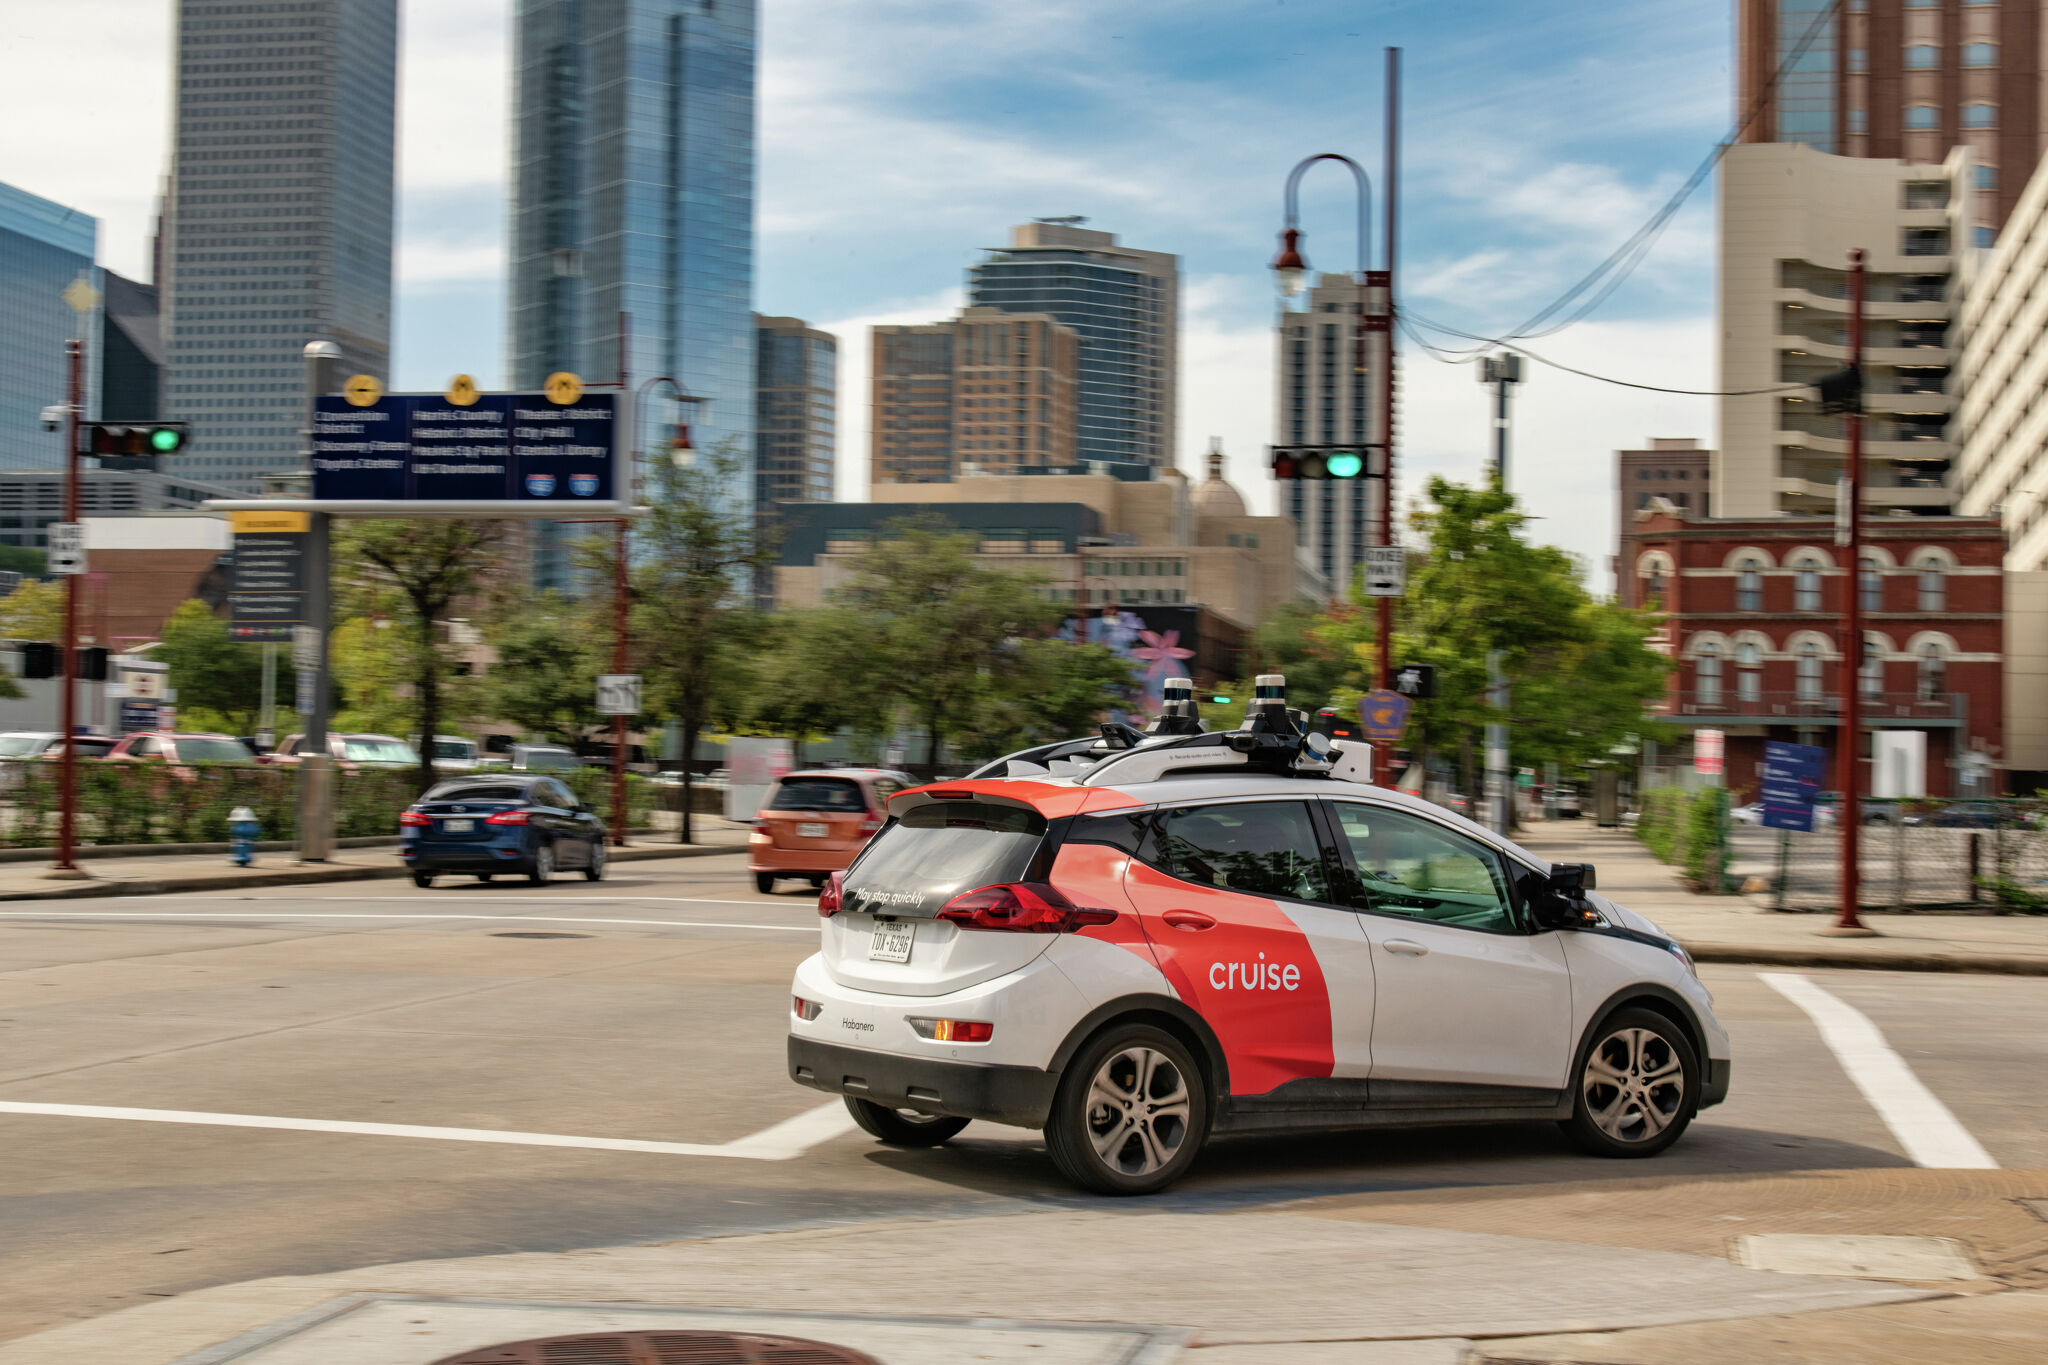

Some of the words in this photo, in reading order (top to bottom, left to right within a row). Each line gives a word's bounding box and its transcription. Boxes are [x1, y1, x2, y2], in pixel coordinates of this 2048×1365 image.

[855, 887, 872, 904] May
[872, 890, 891, 905] stop
[891, 891, 926, 908] quickly
[1209, 951, 1301, 991] cruise
[842, 1016, 875, 1032] Habanero
